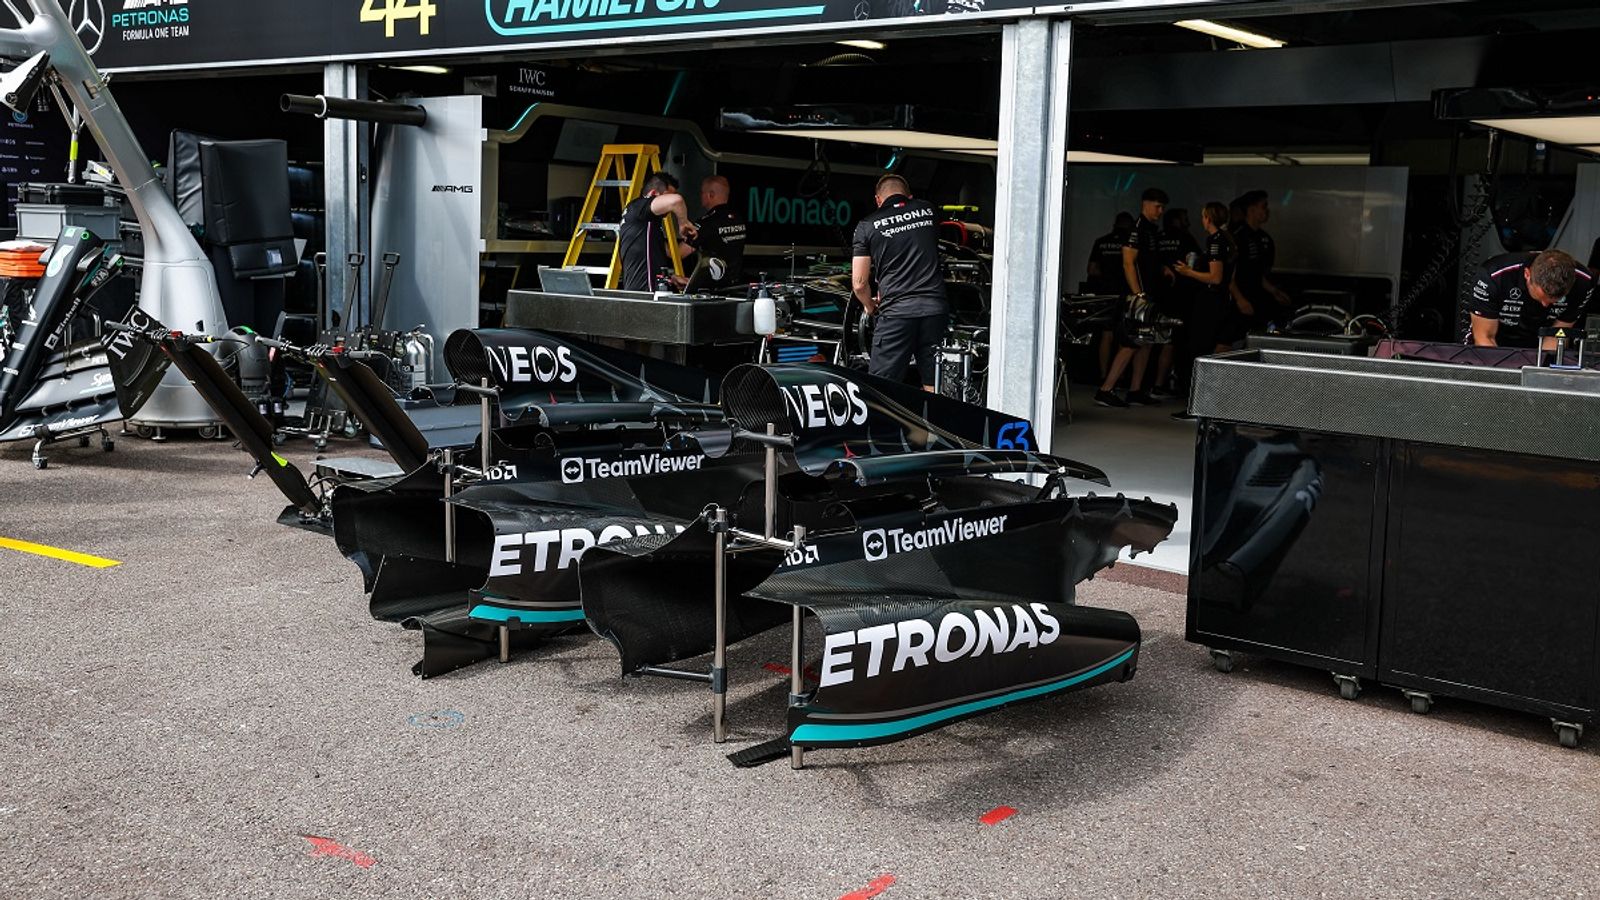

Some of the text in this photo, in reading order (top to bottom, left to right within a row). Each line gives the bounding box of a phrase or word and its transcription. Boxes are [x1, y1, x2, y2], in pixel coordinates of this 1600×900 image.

[112, 7, 189, 27] PETRONAS
[122, 25, 189, 40] FORMULA ONE TEAM
[519, 67, 546, 86] IWC
[748, 187, 851, 226] Monaco
[873, 208, 934, 230] PETRONAS
[55, 297, 81, 335] Einhell
[996, 420, 1030, 451] 63
[586, 453, 705, 479] TeamViewer
[888, 514, 1008, 552] TeamViewer
[489, 525, 687, 577] ETR
[820, 602, 1060, 688] ETRONAS
